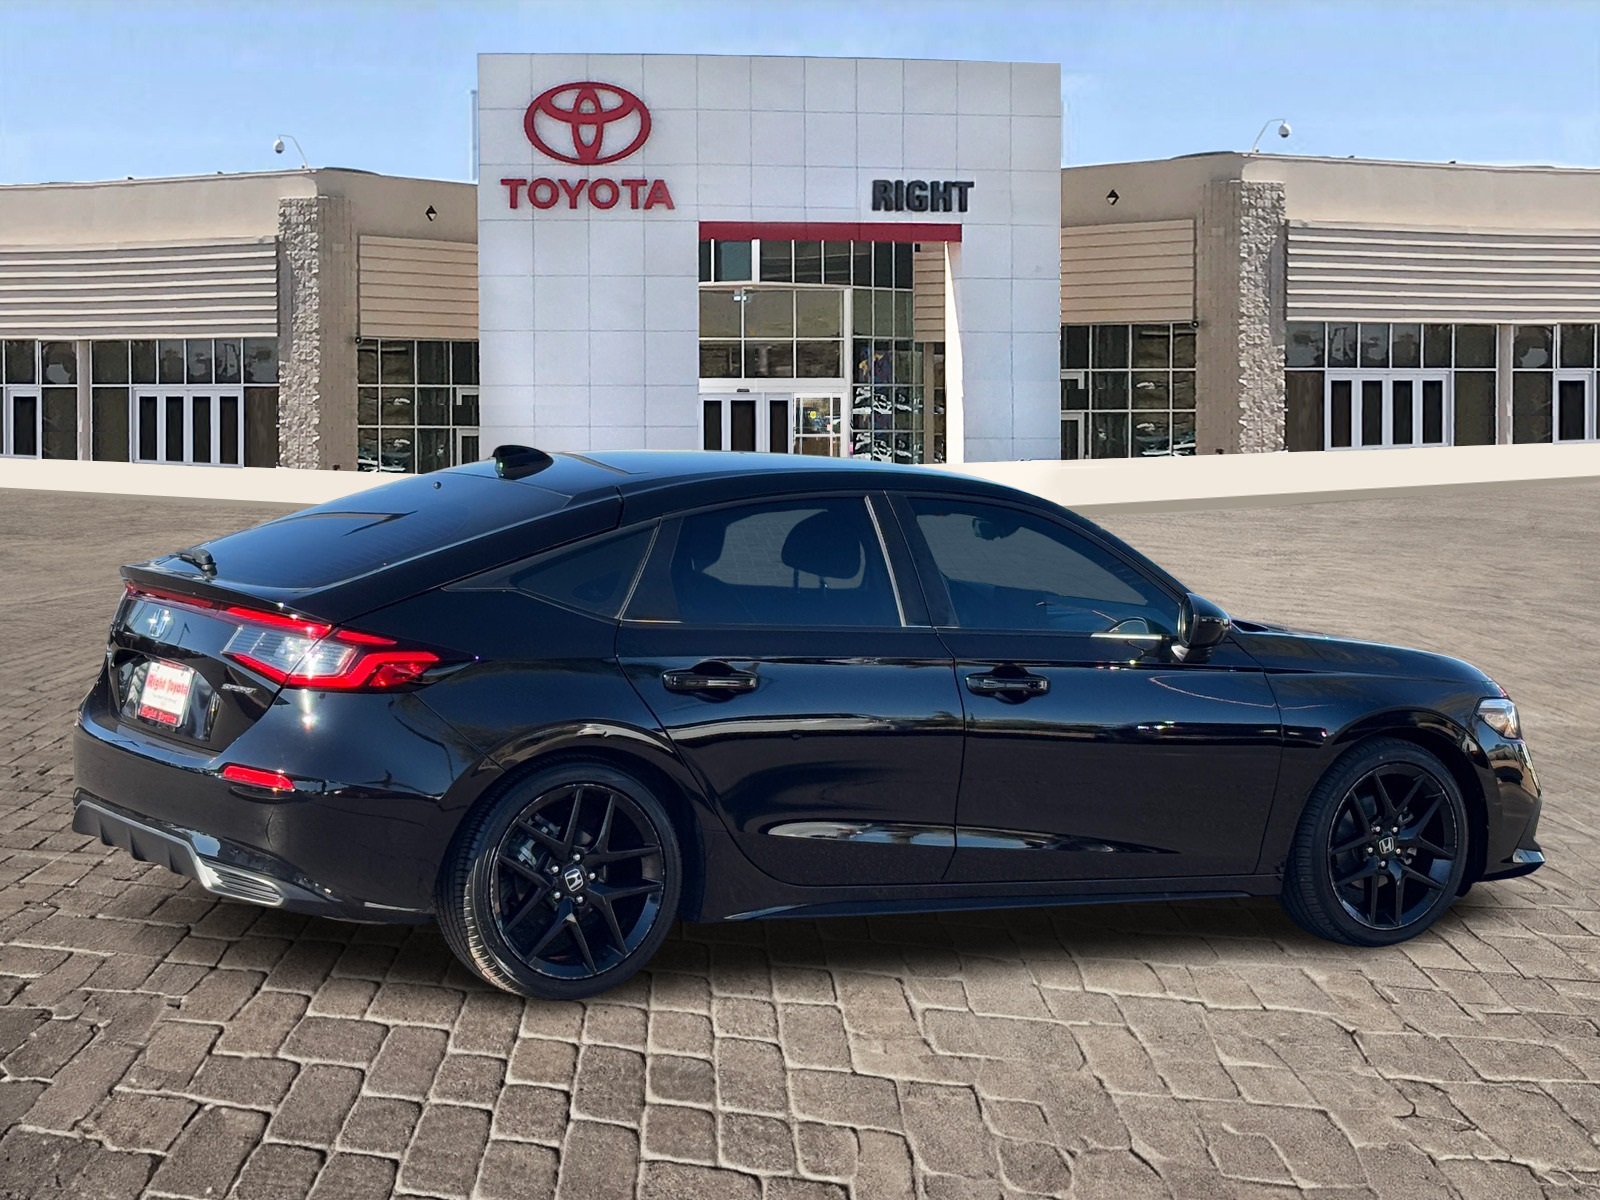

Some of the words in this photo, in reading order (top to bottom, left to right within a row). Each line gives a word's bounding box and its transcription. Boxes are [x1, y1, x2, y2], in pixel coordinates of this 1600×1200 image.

[500, 178, 675, 210] TOYOTA
[872, 179, 975, 212] RIGHT
[146, 674, 166, 691] Right
